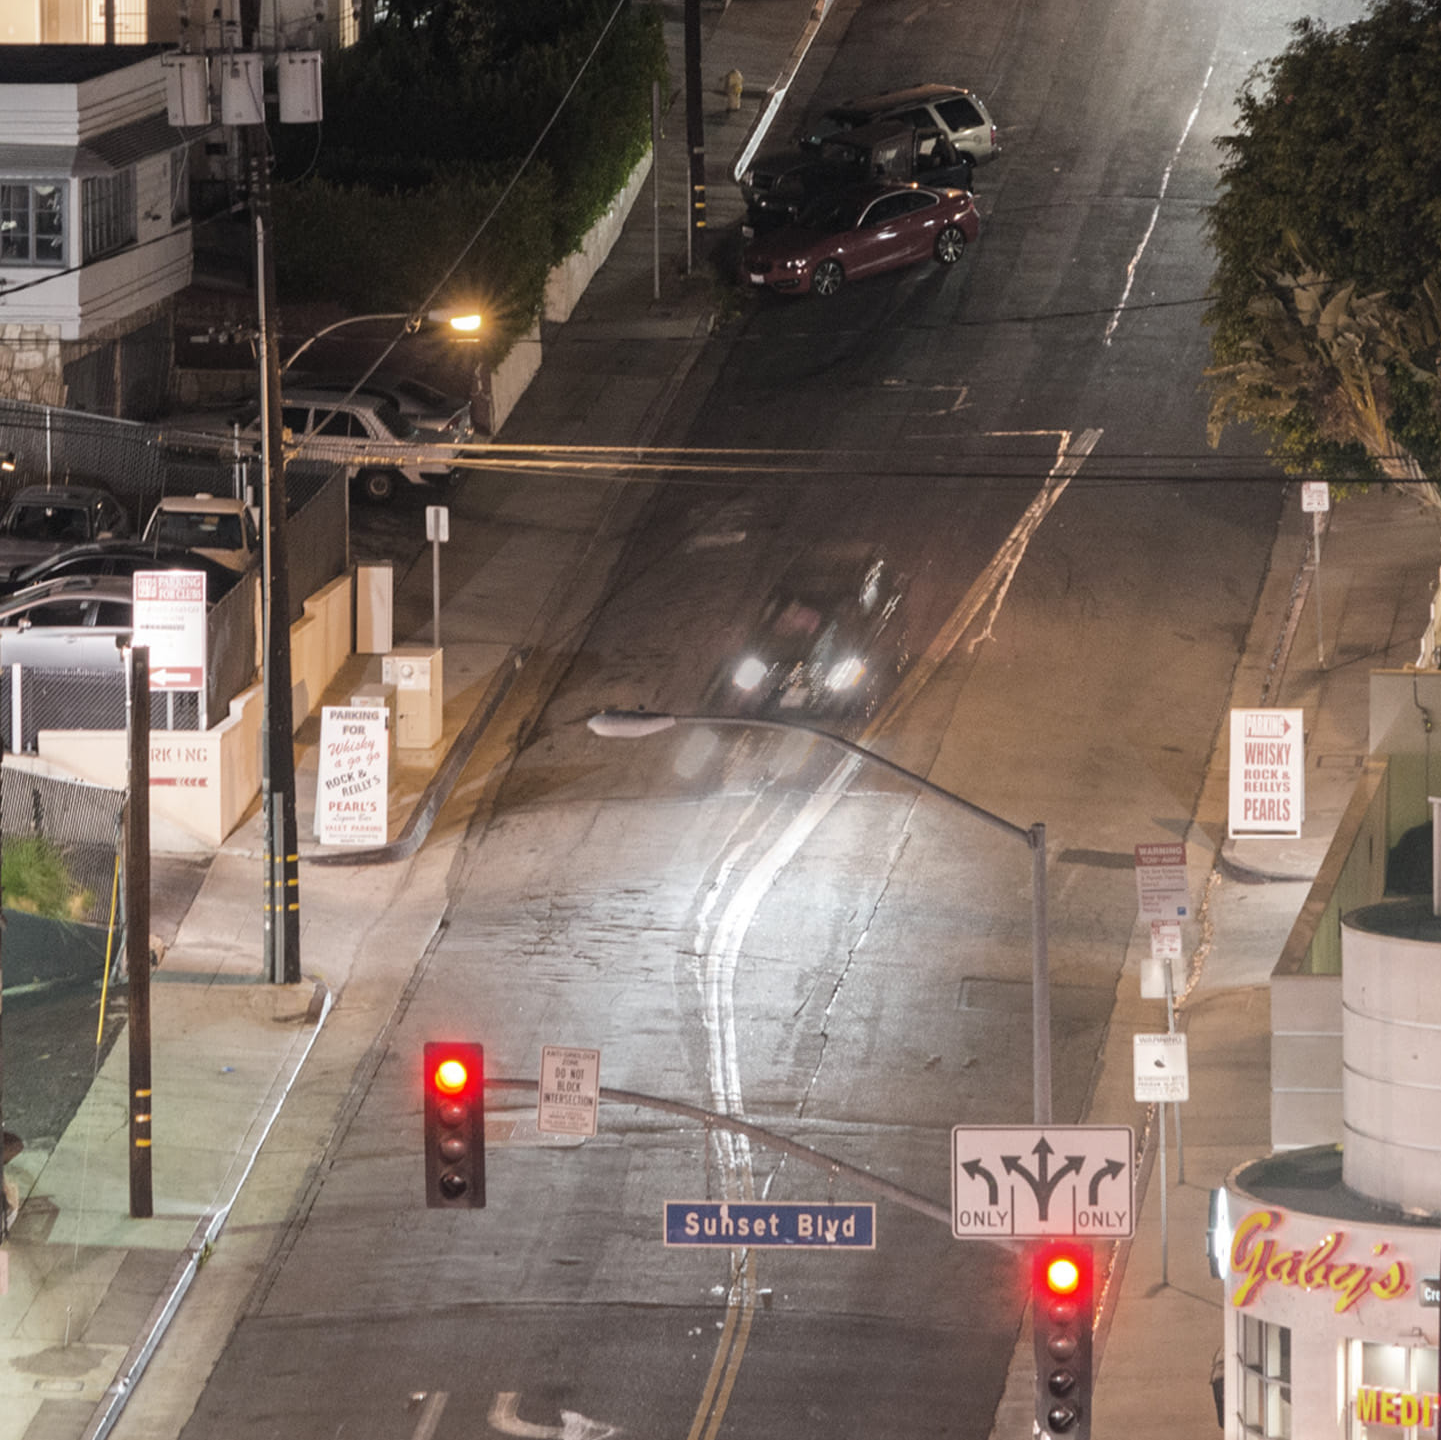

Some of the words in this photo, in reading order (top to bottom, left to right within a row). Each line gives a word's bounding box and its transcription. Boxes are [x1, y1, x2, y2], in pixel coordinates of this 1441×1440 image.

[159, 576, 201, 588] PARKING
[329, 710, 380, 720] PARKING
[342, 725, 366, 735] FOR
[327, 736, 375, 757] Whisky
[1244, 742, 1291, 766] WHISKY
[325, 771, 354, 790] ROCK
[1244, 769, 1278, 780] ROCK
[1244, 781, 1291, 793] REILLYS
[328, 801, 377, 812] PEARL'S
[1243, 798, 1291, 821] PEARLS
[555, 1066, 566, 1079] DO
[570, 1068, 585, 1080] NOT
[556, 1080, 580, 1093] BLOCK
[543, 1092, 594, 1107] INTERSECTION
[685, 1211, 779, 1237] Sunset
[798, 1212, 856, 1238] Blvd
[959, 1210, 1009, 1227] ONLY
[1078, 1210, 1127, 1228] ONLY
[1230, 1210, 1411, 1314] Gaby's
[1357, 1386, 1438, 1428] MEDI
